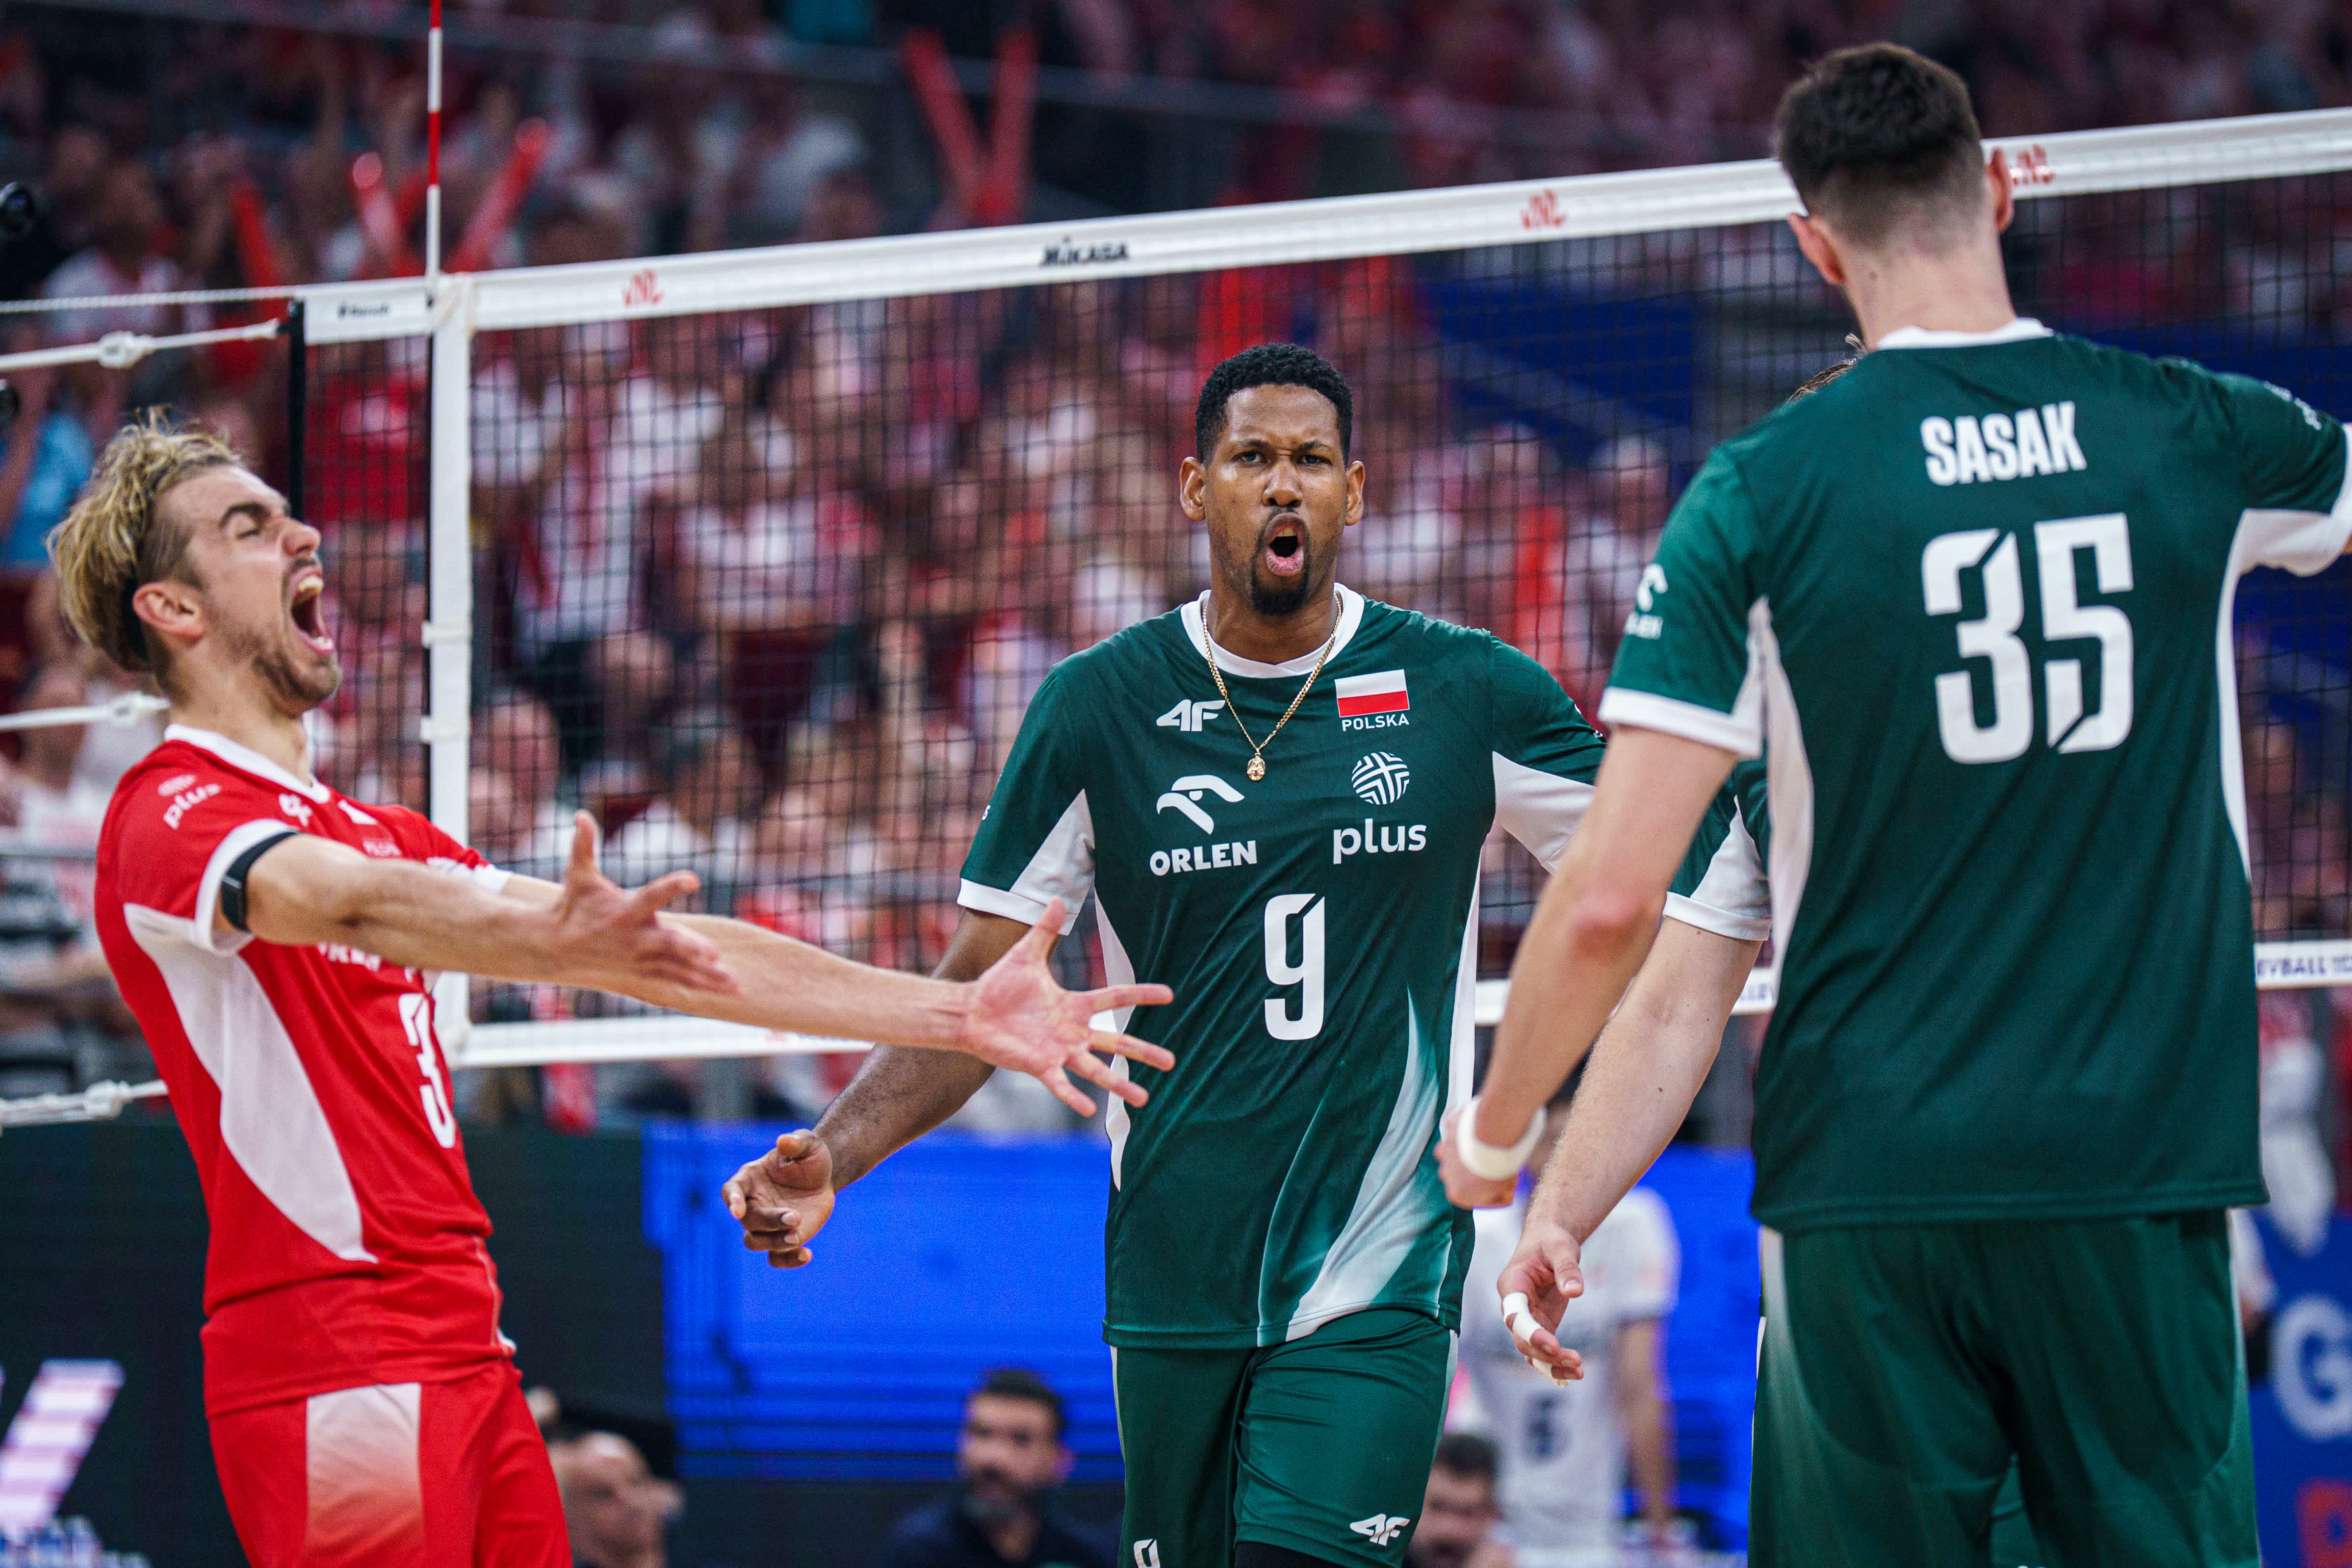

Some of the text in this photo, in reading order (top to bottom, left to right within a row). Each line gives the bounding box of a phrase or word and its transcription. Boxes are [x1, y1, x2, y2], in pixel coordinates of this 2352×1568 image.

[1920, 400, 2087, 486] SASAK
[1920, 512, 2134, 764] 35
[1156, 699, 1226, 732] 4F
[1342, 714, 1409, 731] POLSKA
[1150, 840, 1257, 876] ORLEN
[1333, 818, 1427, 865] plus
[1264, 893, 1324, 1040] 9
[398, 993, 455, 1148] 3
[1350, 1514, 1410, 1546] 4F
